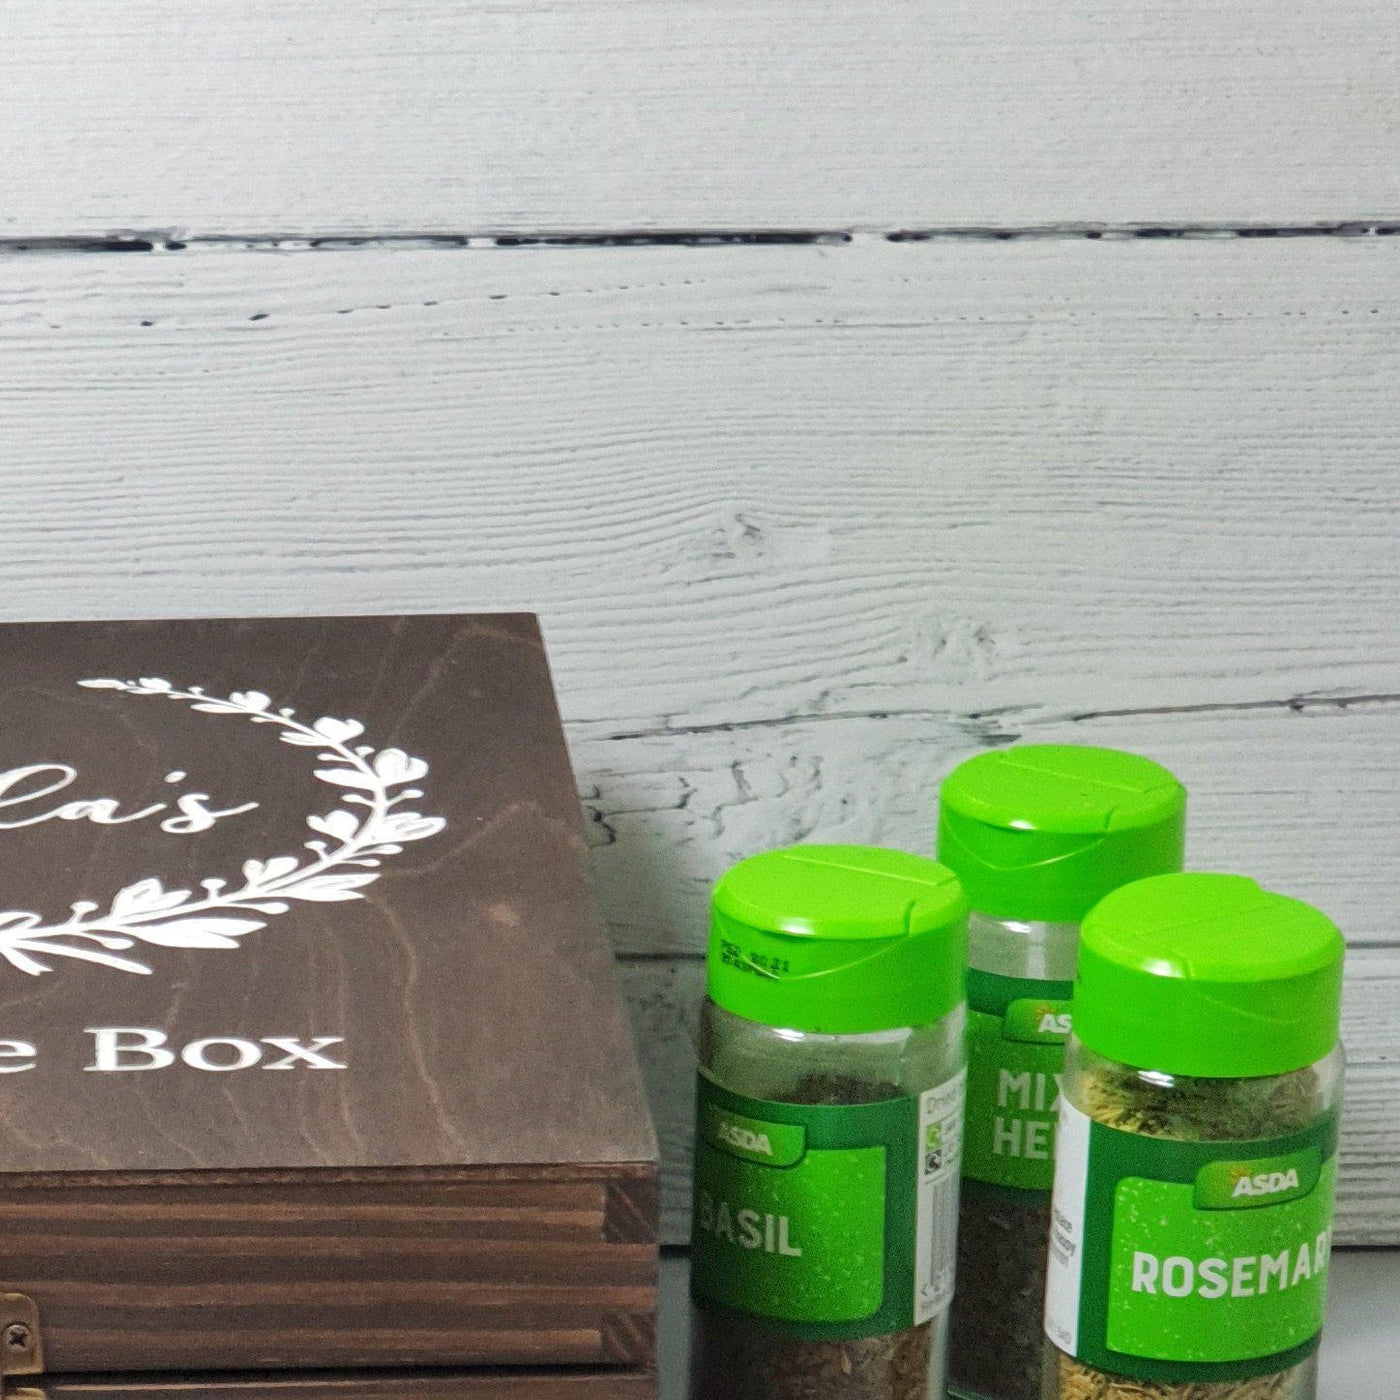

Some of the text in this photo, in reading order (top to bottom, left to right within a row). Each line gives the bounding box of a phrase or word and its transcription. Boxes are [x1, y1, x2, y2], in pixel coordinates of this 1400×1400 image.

[1037, 1013, 1072, 1034] AS
[83, 1027, 349, 1072] Box
[717, 1121, 773, 1157] ASDA
[992, 1116, 1050, 1159] HE
[1232, 1168, 1300, 1198] ASDA
[1130, 1224, 1332, 1299] ROSEMAR
